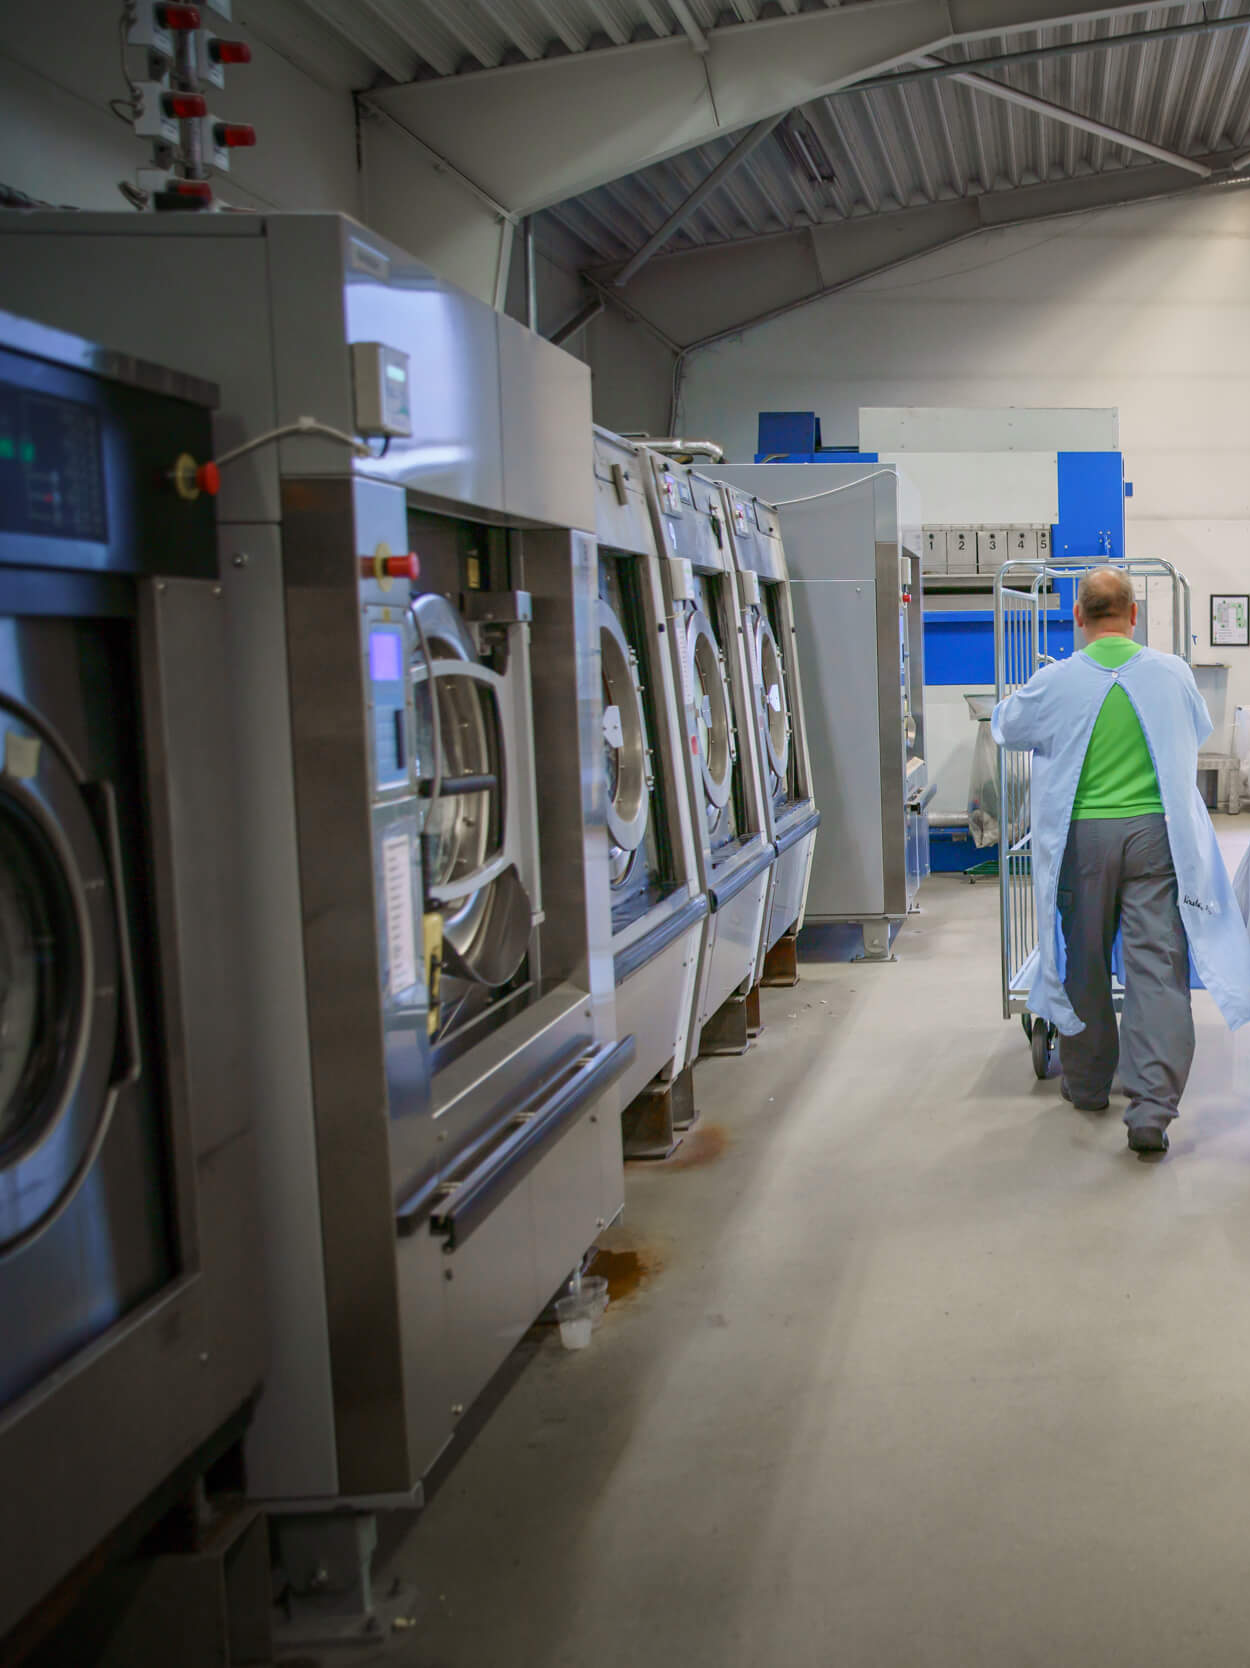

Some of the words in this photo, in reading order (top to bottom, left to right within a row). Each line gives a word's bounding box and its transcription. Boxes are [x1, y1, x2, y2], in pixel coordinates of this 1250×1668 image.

[929, 541, 934, 550] 1
[958, 540, 965, 550] 2
[989, 540, 996, 550] 3
[1017, 540, 1024, 549] 4
[1040, 540, 1047, 549] 5
